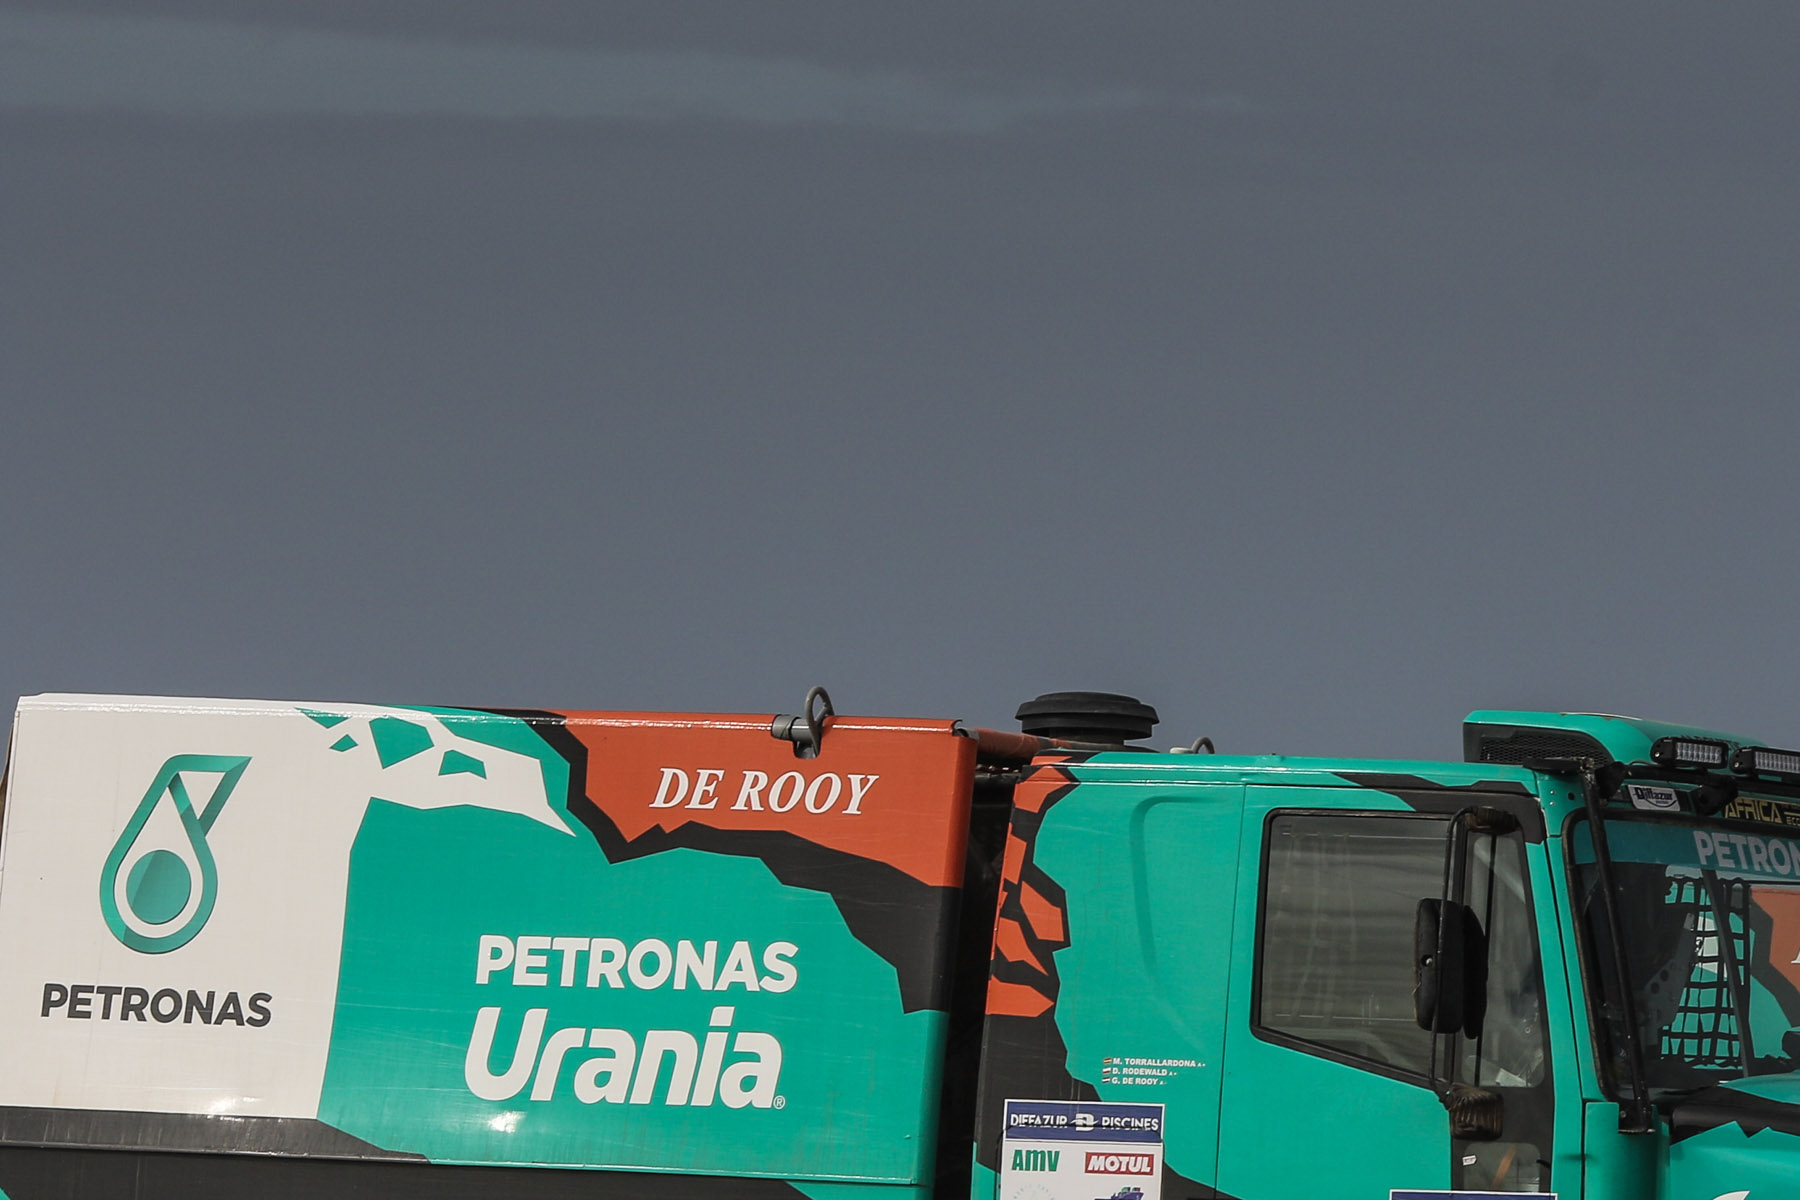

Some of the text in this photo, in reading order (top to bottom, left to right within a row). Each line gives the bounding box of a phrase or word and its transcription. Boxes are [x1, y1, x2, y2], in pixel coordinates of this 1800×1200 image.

[650, 768, 878, 814] DE ROOY
[1725, 797, 1783, 823] AFRICA
[476, 935, 798, 992] PETRONAS
[40, 983, 272, 1027] PETRONAS
[464, 1006, 784, 1108] Urania
[1112, 1057, 1122, 1066] M.
[1125, 1058, 1196, 1067] TORRALLARDONA
[1112, 1067, 1120, 1075] D.
[1122, 1068, 1168, 1076] RODEWALD
[1122, 1077, 1134, 1085] DE
[1088, 1154, 1151, 1173] MOTUL
